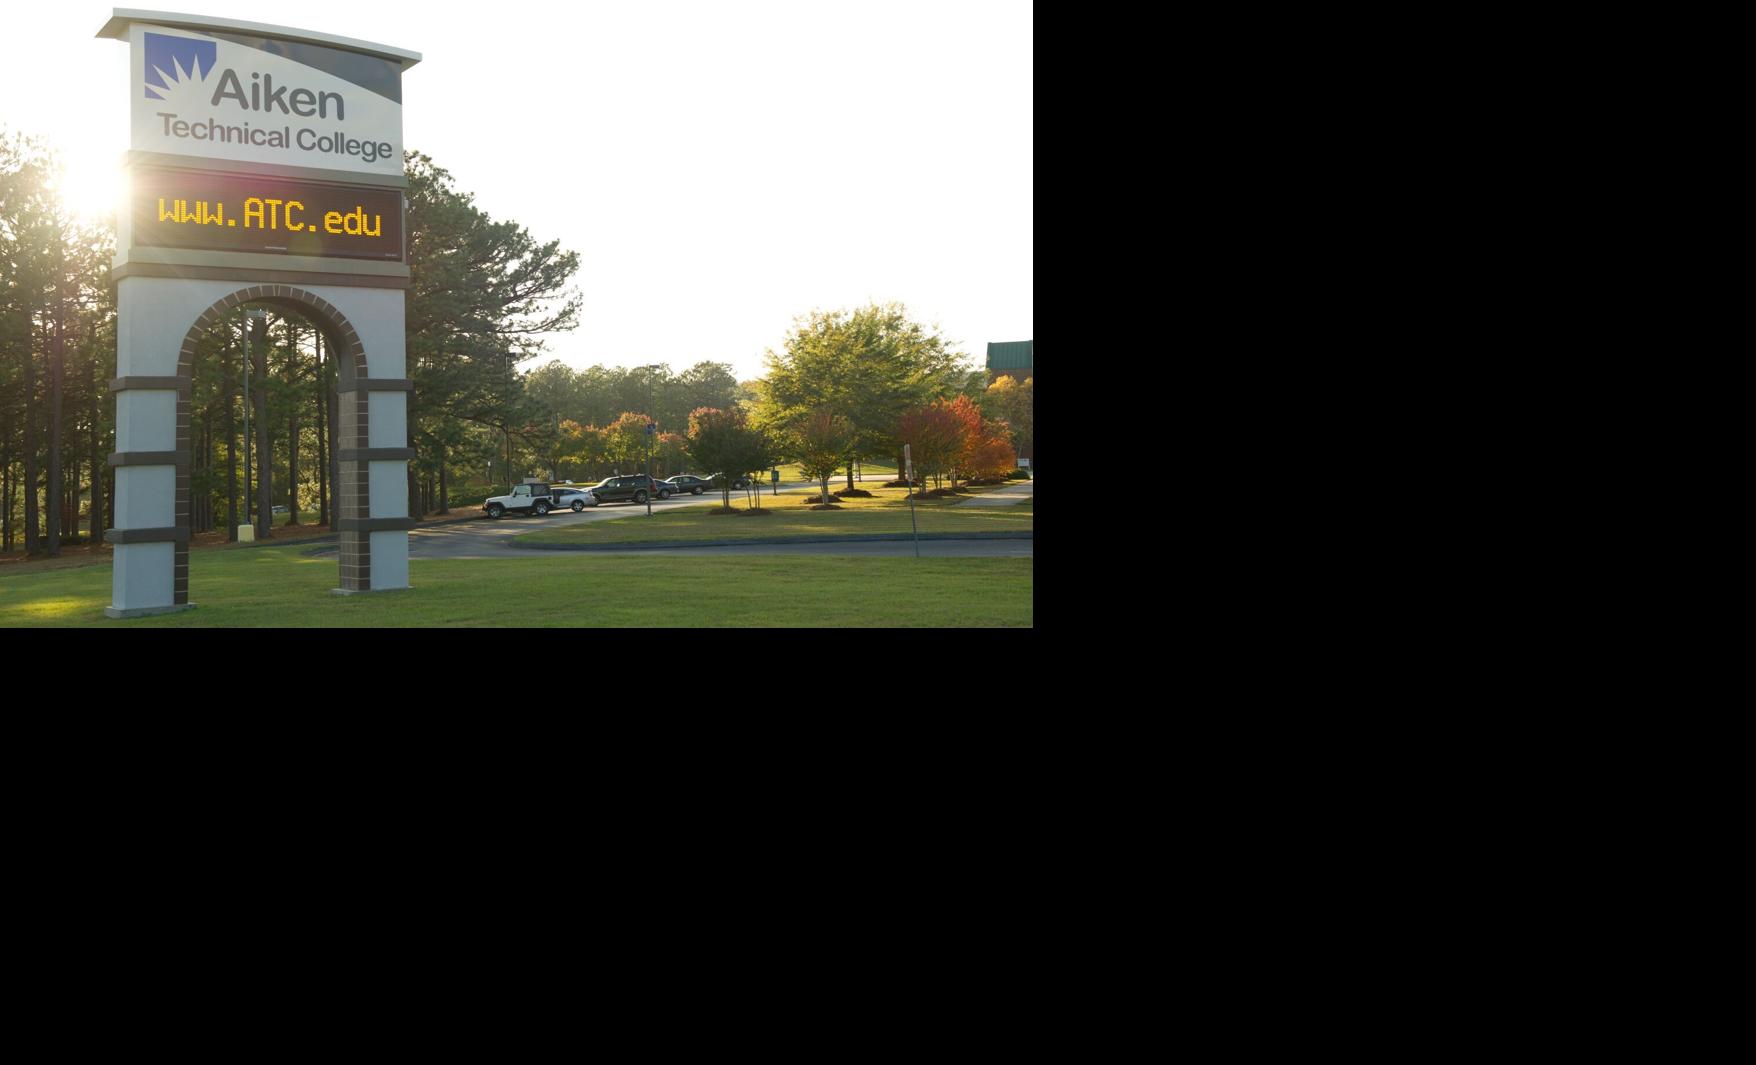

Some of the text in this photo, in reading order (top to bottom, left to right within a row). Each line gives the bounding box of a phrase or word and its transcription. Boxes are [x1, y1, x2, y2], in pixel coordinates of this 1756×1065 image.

[211, 68, 345, 121] Aiken
[157, 112, 393, 163] Technical College
[159, 197, 381, 237] www.ATC.edu
